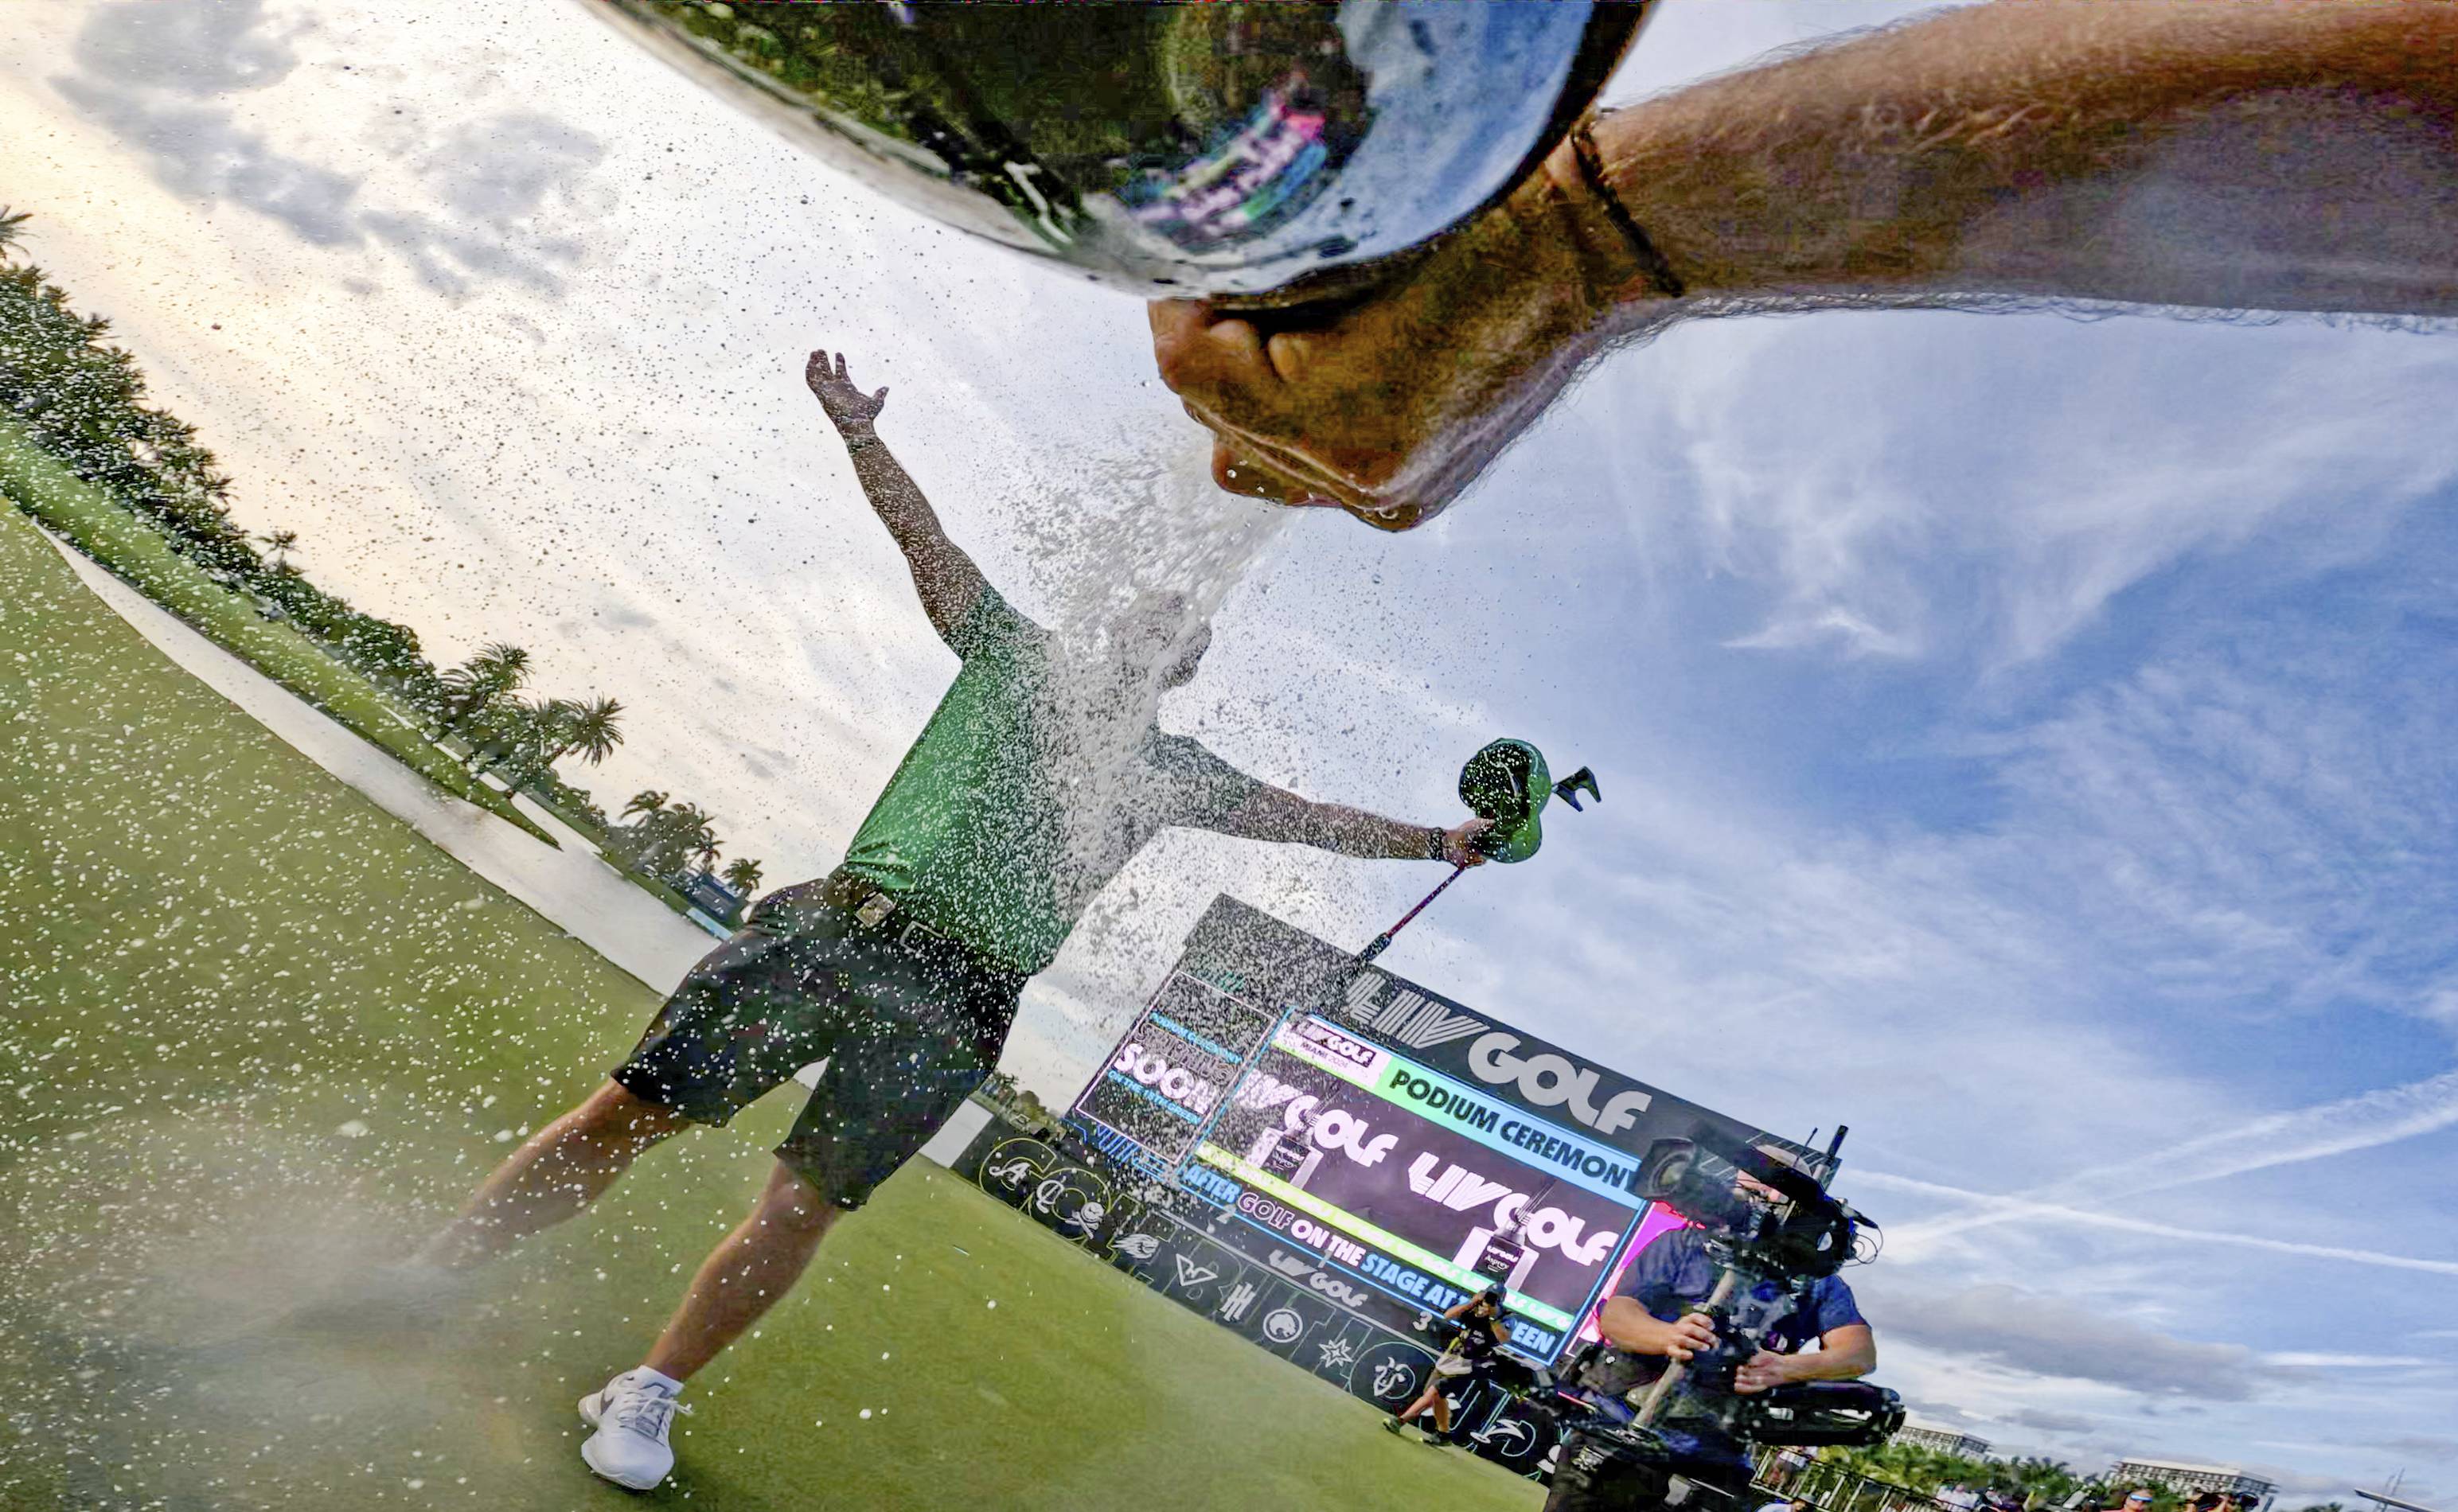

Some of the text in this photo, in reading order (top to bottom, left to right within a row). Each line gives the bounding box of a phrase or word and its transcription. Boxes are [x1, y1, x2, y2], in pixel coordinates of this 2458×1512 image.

[1106, 1068, 1125, 1083] ON
[1114, 1042, 1216, 1114] SOON
[1300, 1040, 1328, 1059] MIAMI
[1326, 1035, 1374, 1065] GOLF
[1343, 972, 1652, 1135] LIV GOLF
[1284, 1094, 1399, 1167] GOLF
[1389, 1069, 1500, 1135] PODIUM
[1407, 1151, 1513, 1212] LIV
[1492, 1192, 1620, 1267] GOLF
[1184, 1164, 1241, 1202] AFTER
[1238, 1192, 1296, 1229] GOLF
[1290, 1218, 1330, 1249] ON
[1328, 1233, 1367, 1267] THE
[1360, 1253, 1430, 1297] STAGE
[1423, 1283, 1457, 1310] AT
[1511, 1319, 1556, 1354] EEN
[1268, 1248, 1369, 1307] LIV GOLF
[1411, 1310, 1434, 1332] 3
